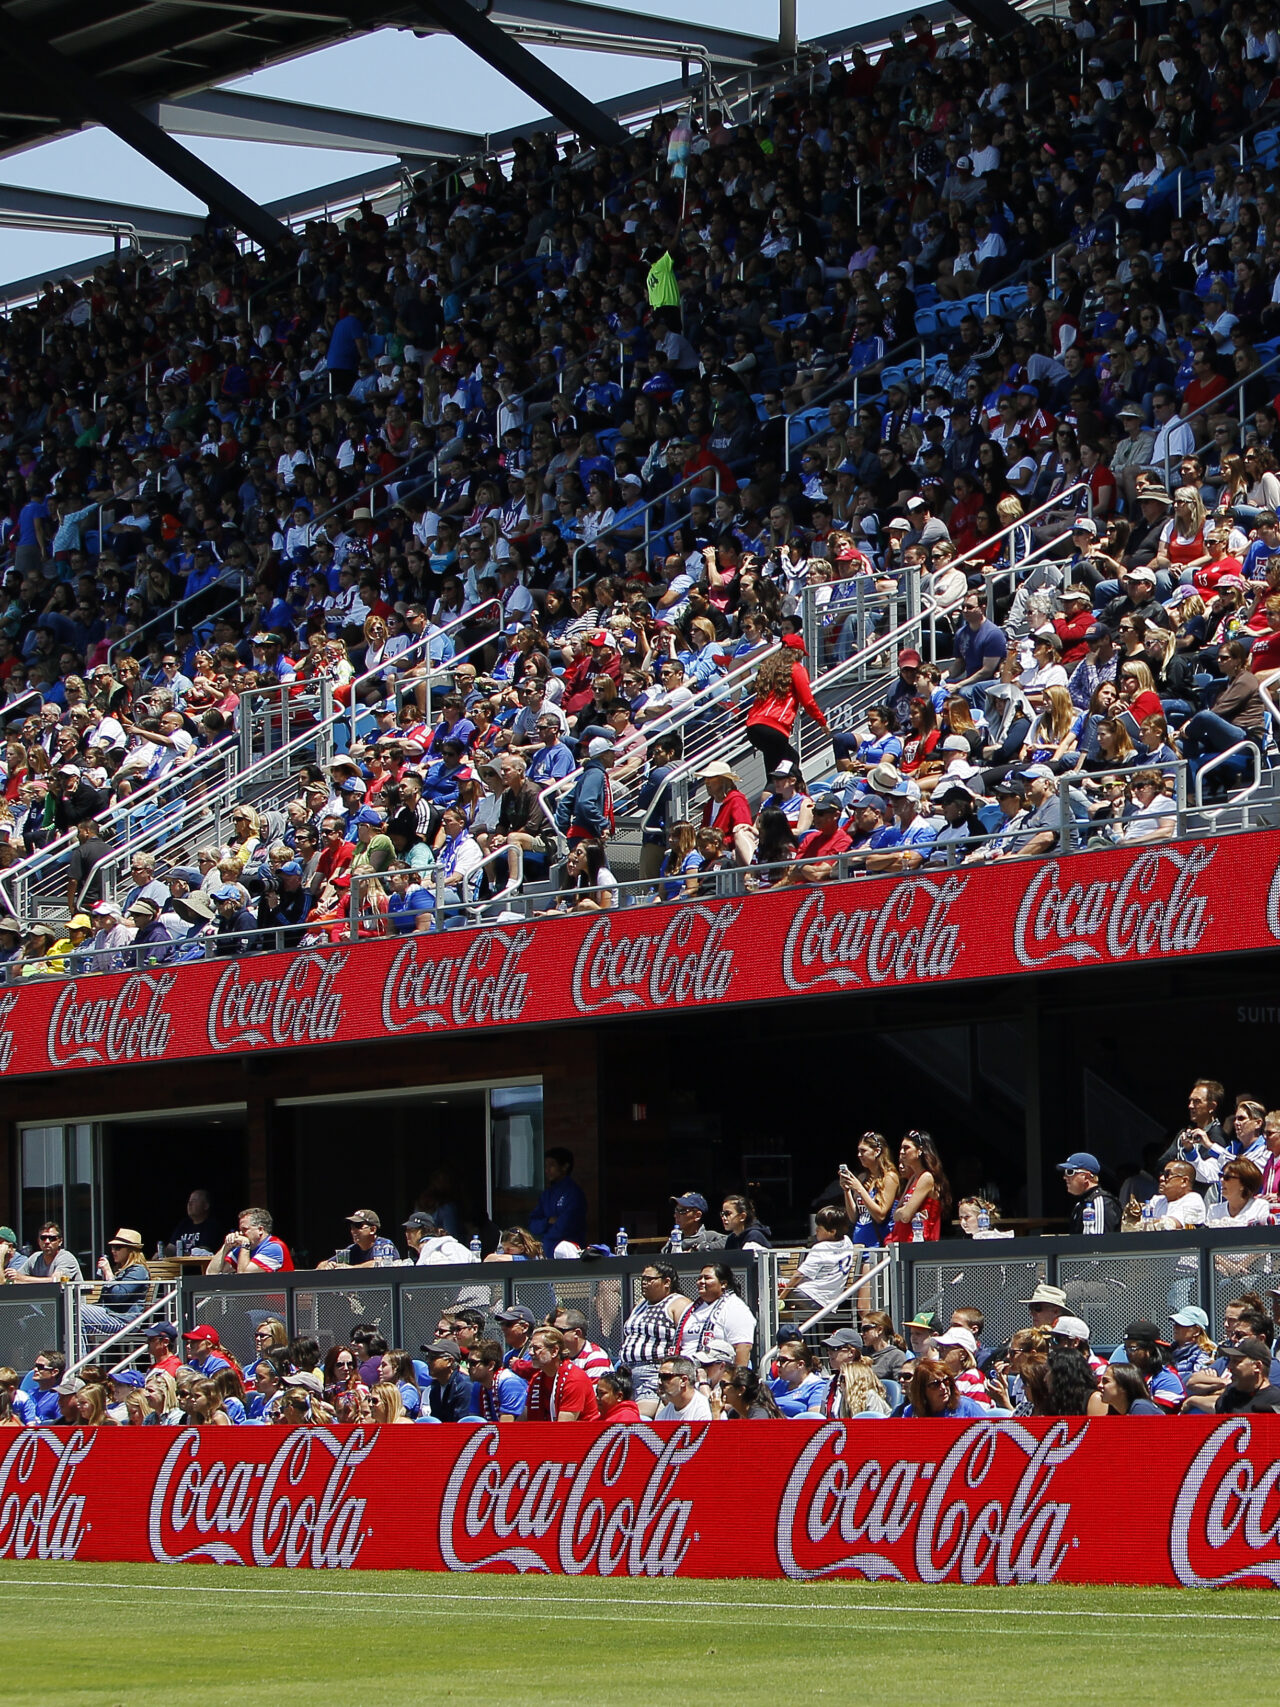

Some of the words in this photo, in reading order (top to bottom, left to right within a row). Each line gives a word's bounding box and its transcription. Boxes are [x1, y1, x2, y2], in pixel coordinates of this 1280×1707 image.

[47, 972, 178, 1066] Coca-Cola
[206, 951, 351, 1051] Coca-Cola
[381, 926, 538, 1032] Coca-Cola
[571, 902, 744, 1013] Coca-Cola
[783, 875, 970, 994] Coca-Cola
[1014, 843, 1217, 968] Coca-Cola
[149, 1426, 381, 1569] Coca-Cola
[440, 1423, 709, 1577] Coca-Cola
[776, 1419, 1091, 1585] Coca-Cola
